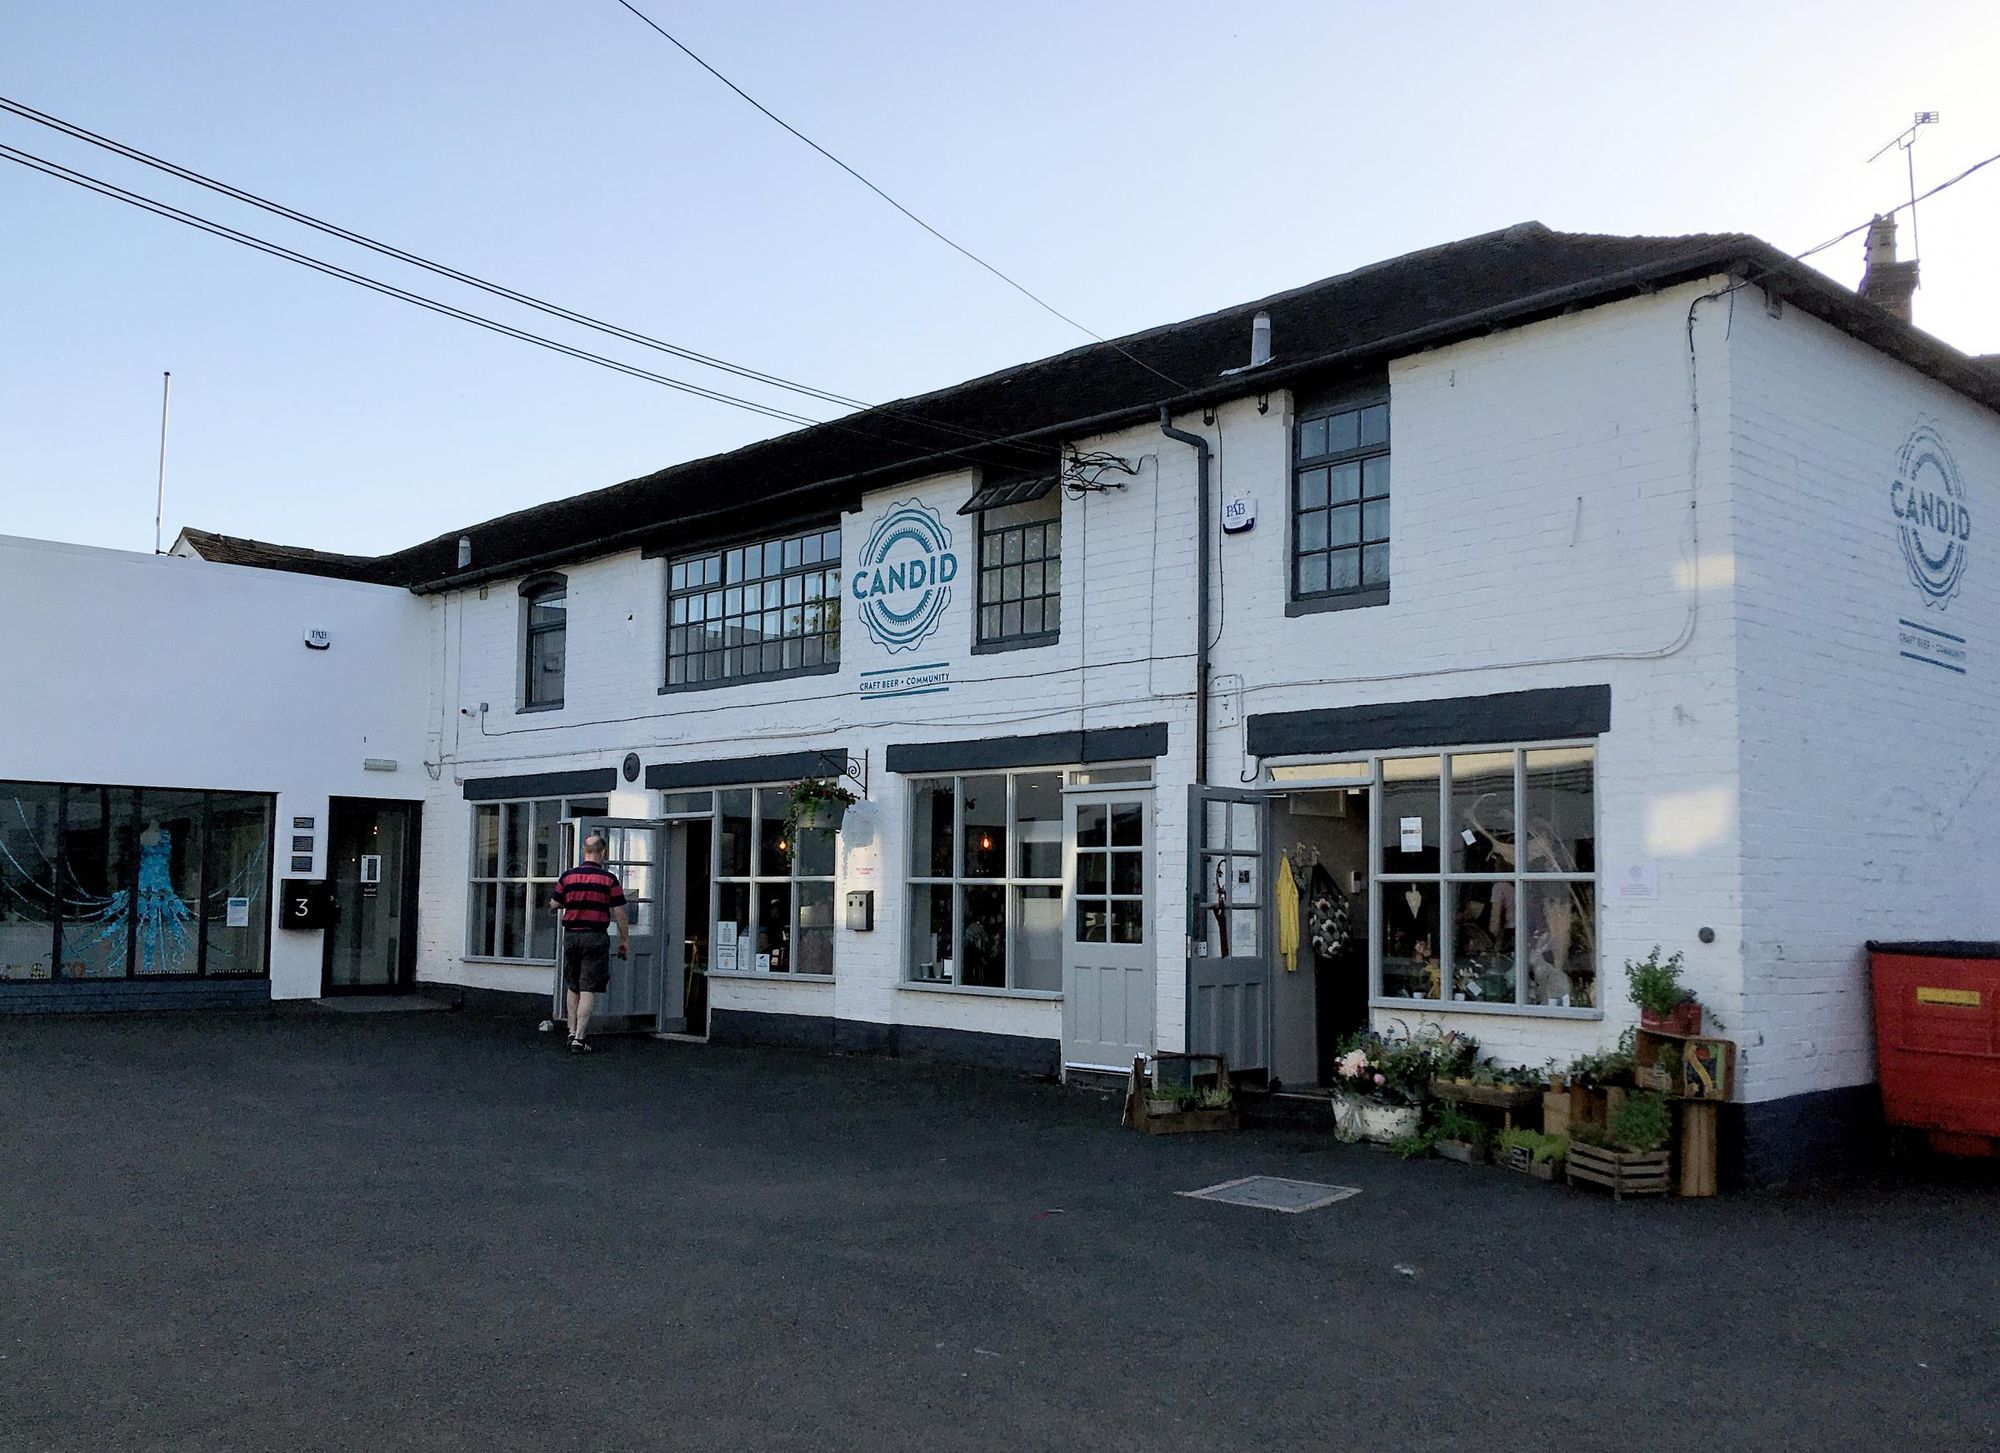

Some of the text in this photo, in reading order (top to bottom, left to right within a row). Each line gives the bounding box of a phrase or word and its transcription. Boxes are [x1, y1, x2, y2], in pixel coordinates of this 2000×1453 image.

[1226, 502, 1246, 517] PAB
[1890, 479, 1971, 541] CANDID
[852, 553, 958, 600] CANDID
[859, 673, 950, 691] CRAFT BEER COMMUNITY
[295, 898, 309, 917] 3
